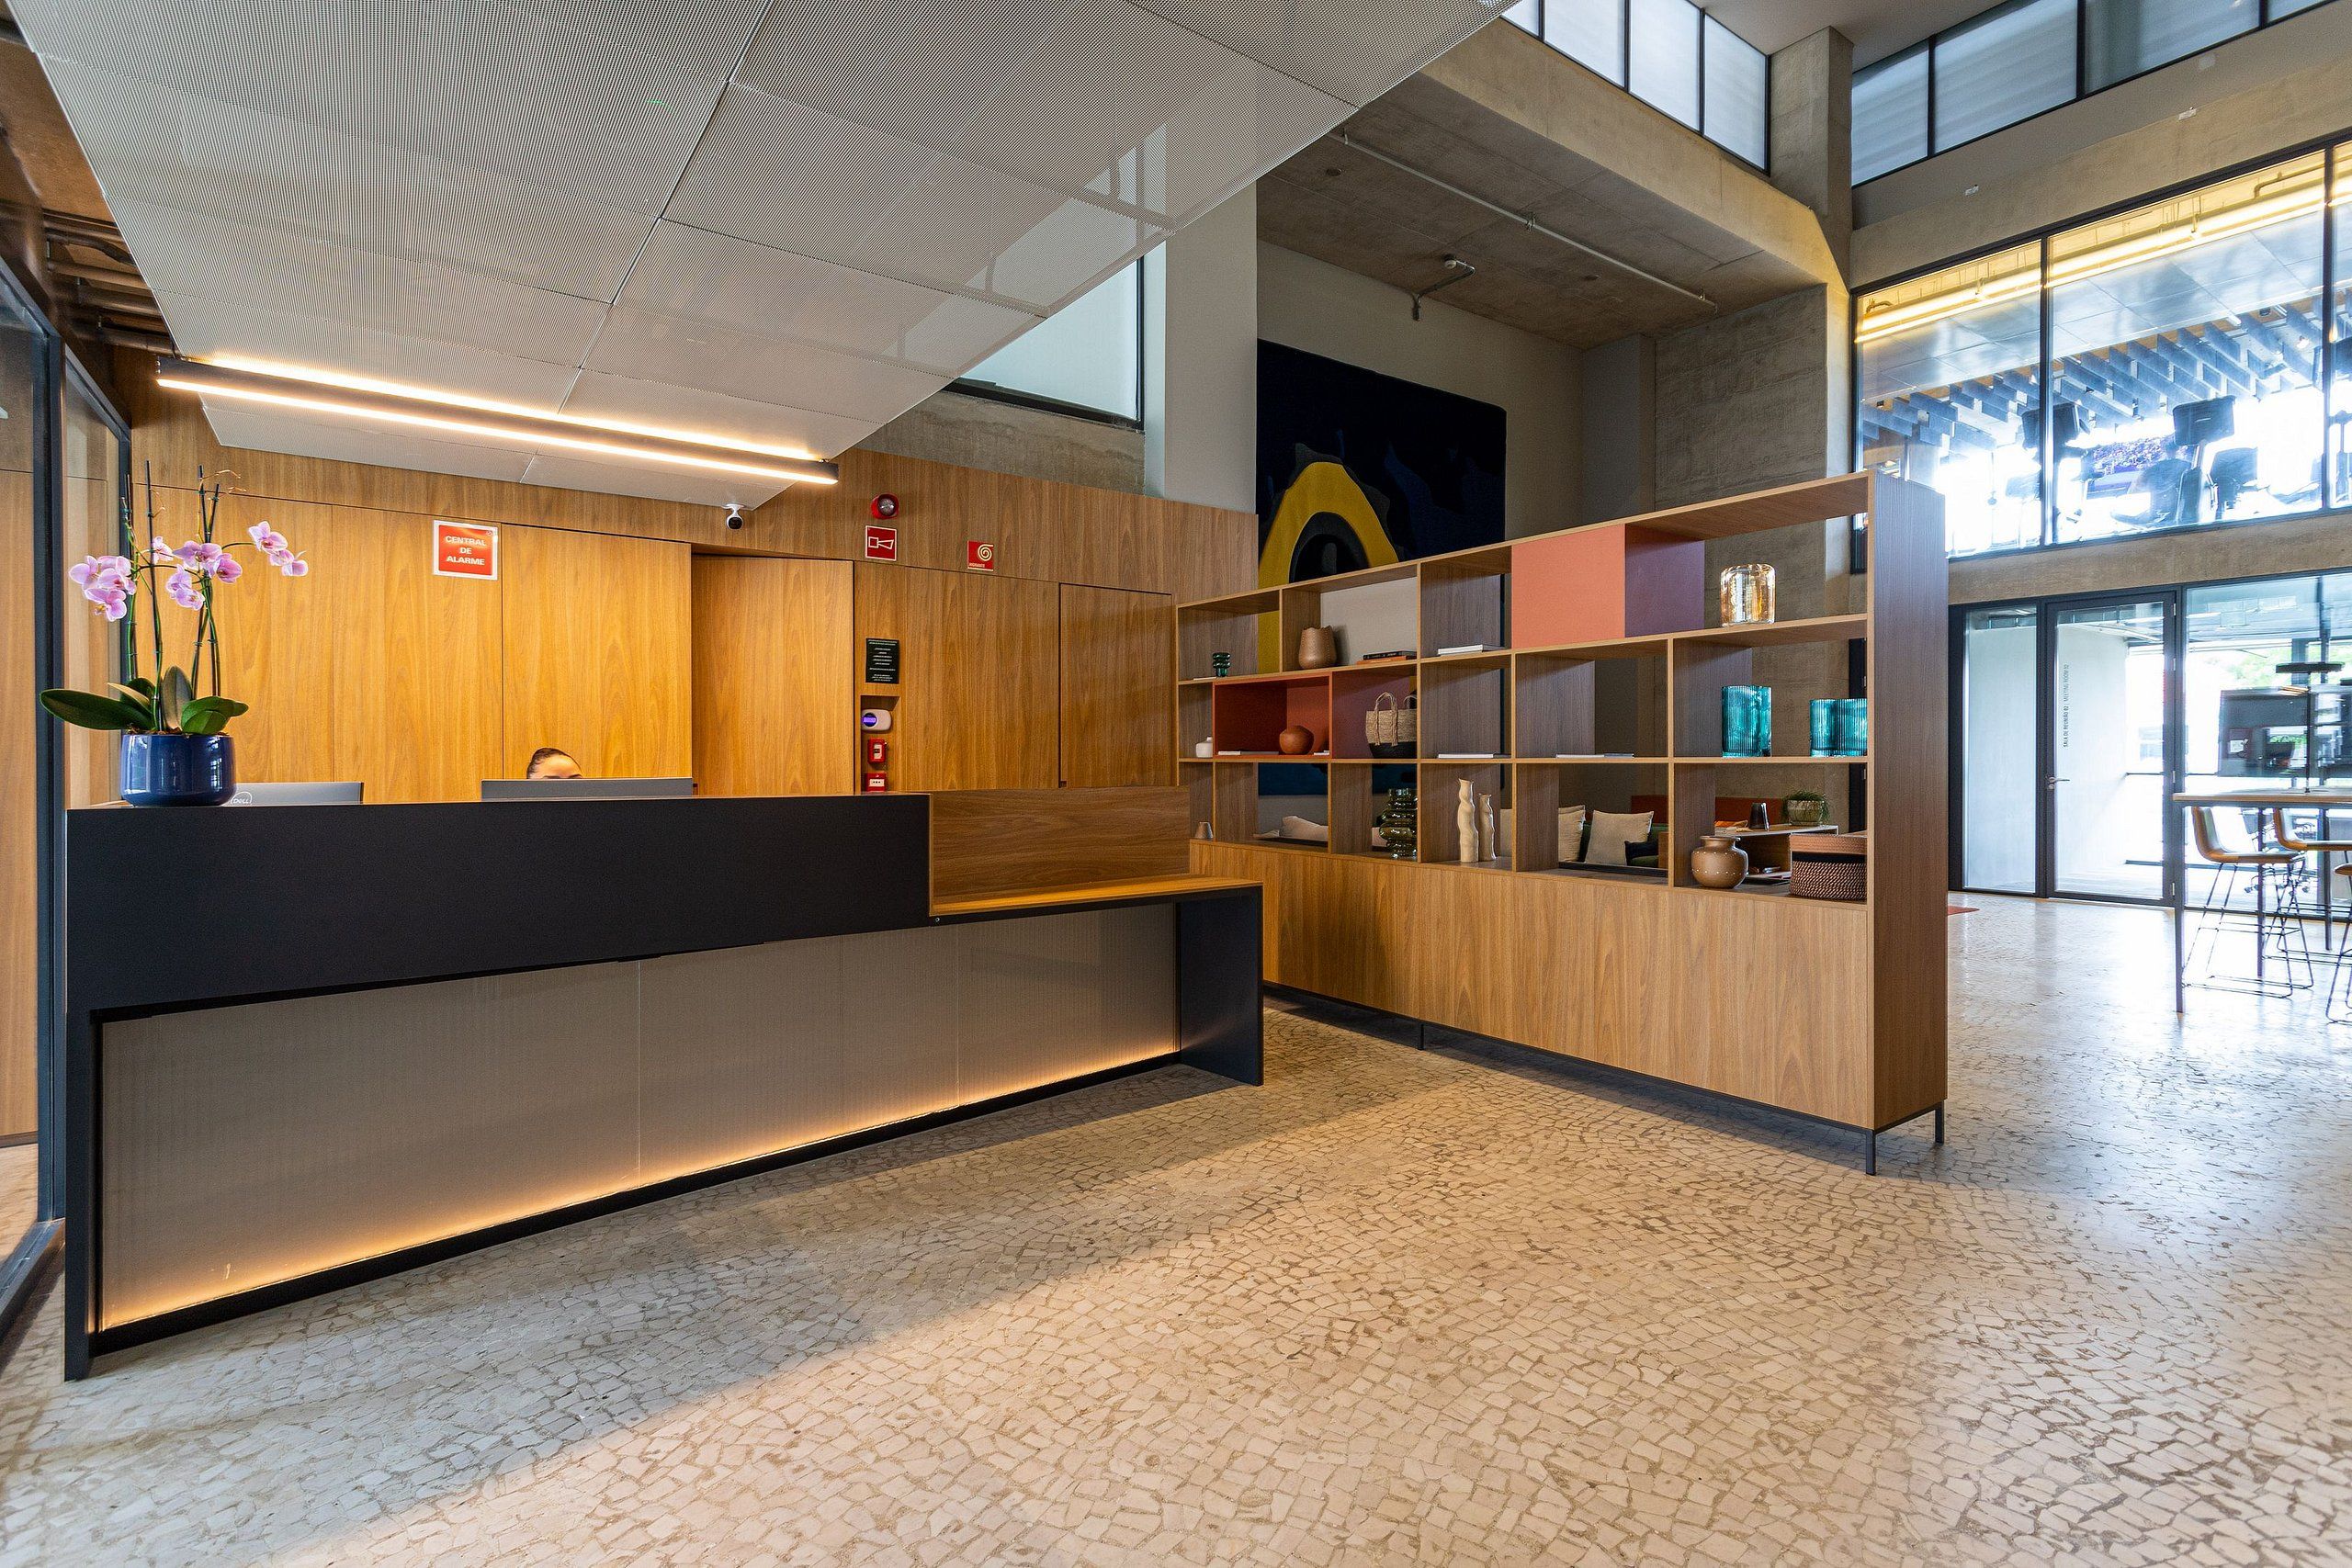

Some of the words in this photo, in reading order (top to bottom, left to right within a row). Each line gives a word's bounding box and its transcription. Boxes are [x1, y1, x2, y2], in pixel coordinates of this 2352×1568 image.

[446, 536, 486, 547] CENTRAL
[459, 547, 472, 555] DE
[447, 556, 485, 566] ALARME
